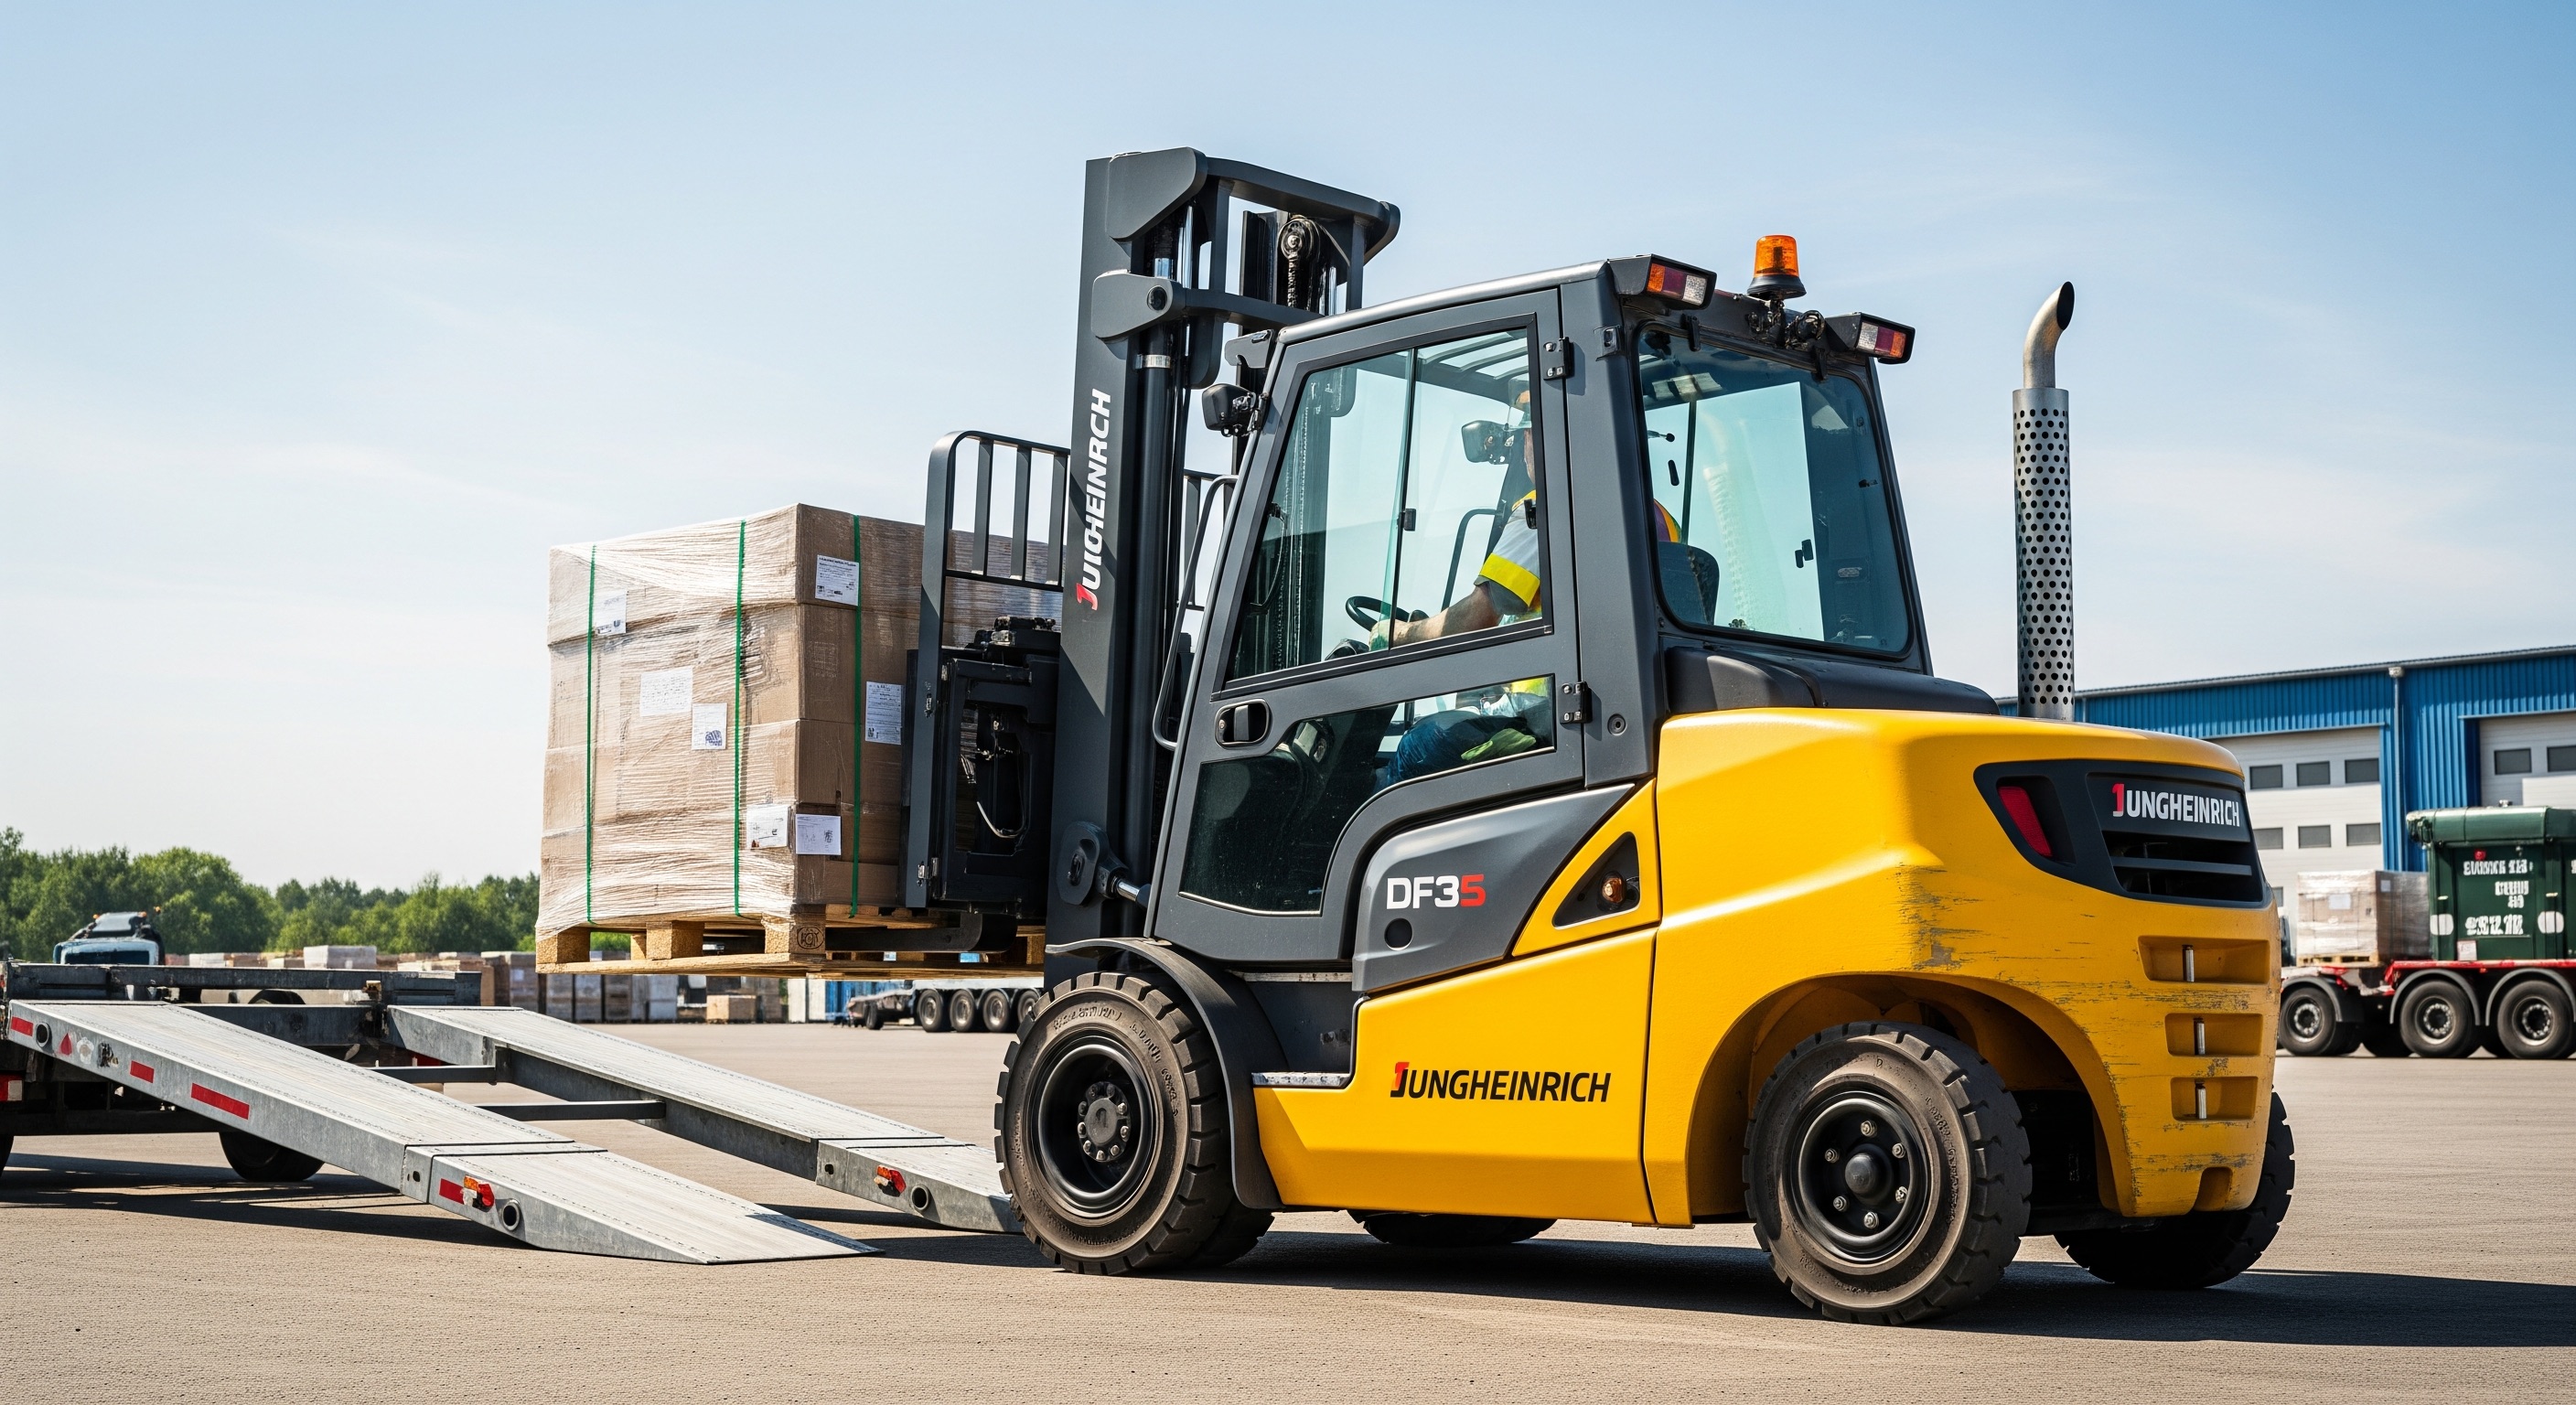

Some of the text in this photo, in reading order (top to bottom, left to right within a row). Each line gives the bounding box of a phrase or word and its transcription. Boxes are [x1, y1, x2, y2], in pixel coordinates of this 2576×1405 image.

[2111, 783, 2240, 827] JUNGHEINRICH
[1386, 874, 1487, 910] DF35
[1390, 1061, 1612, 1103] JUNGHEINRICH
